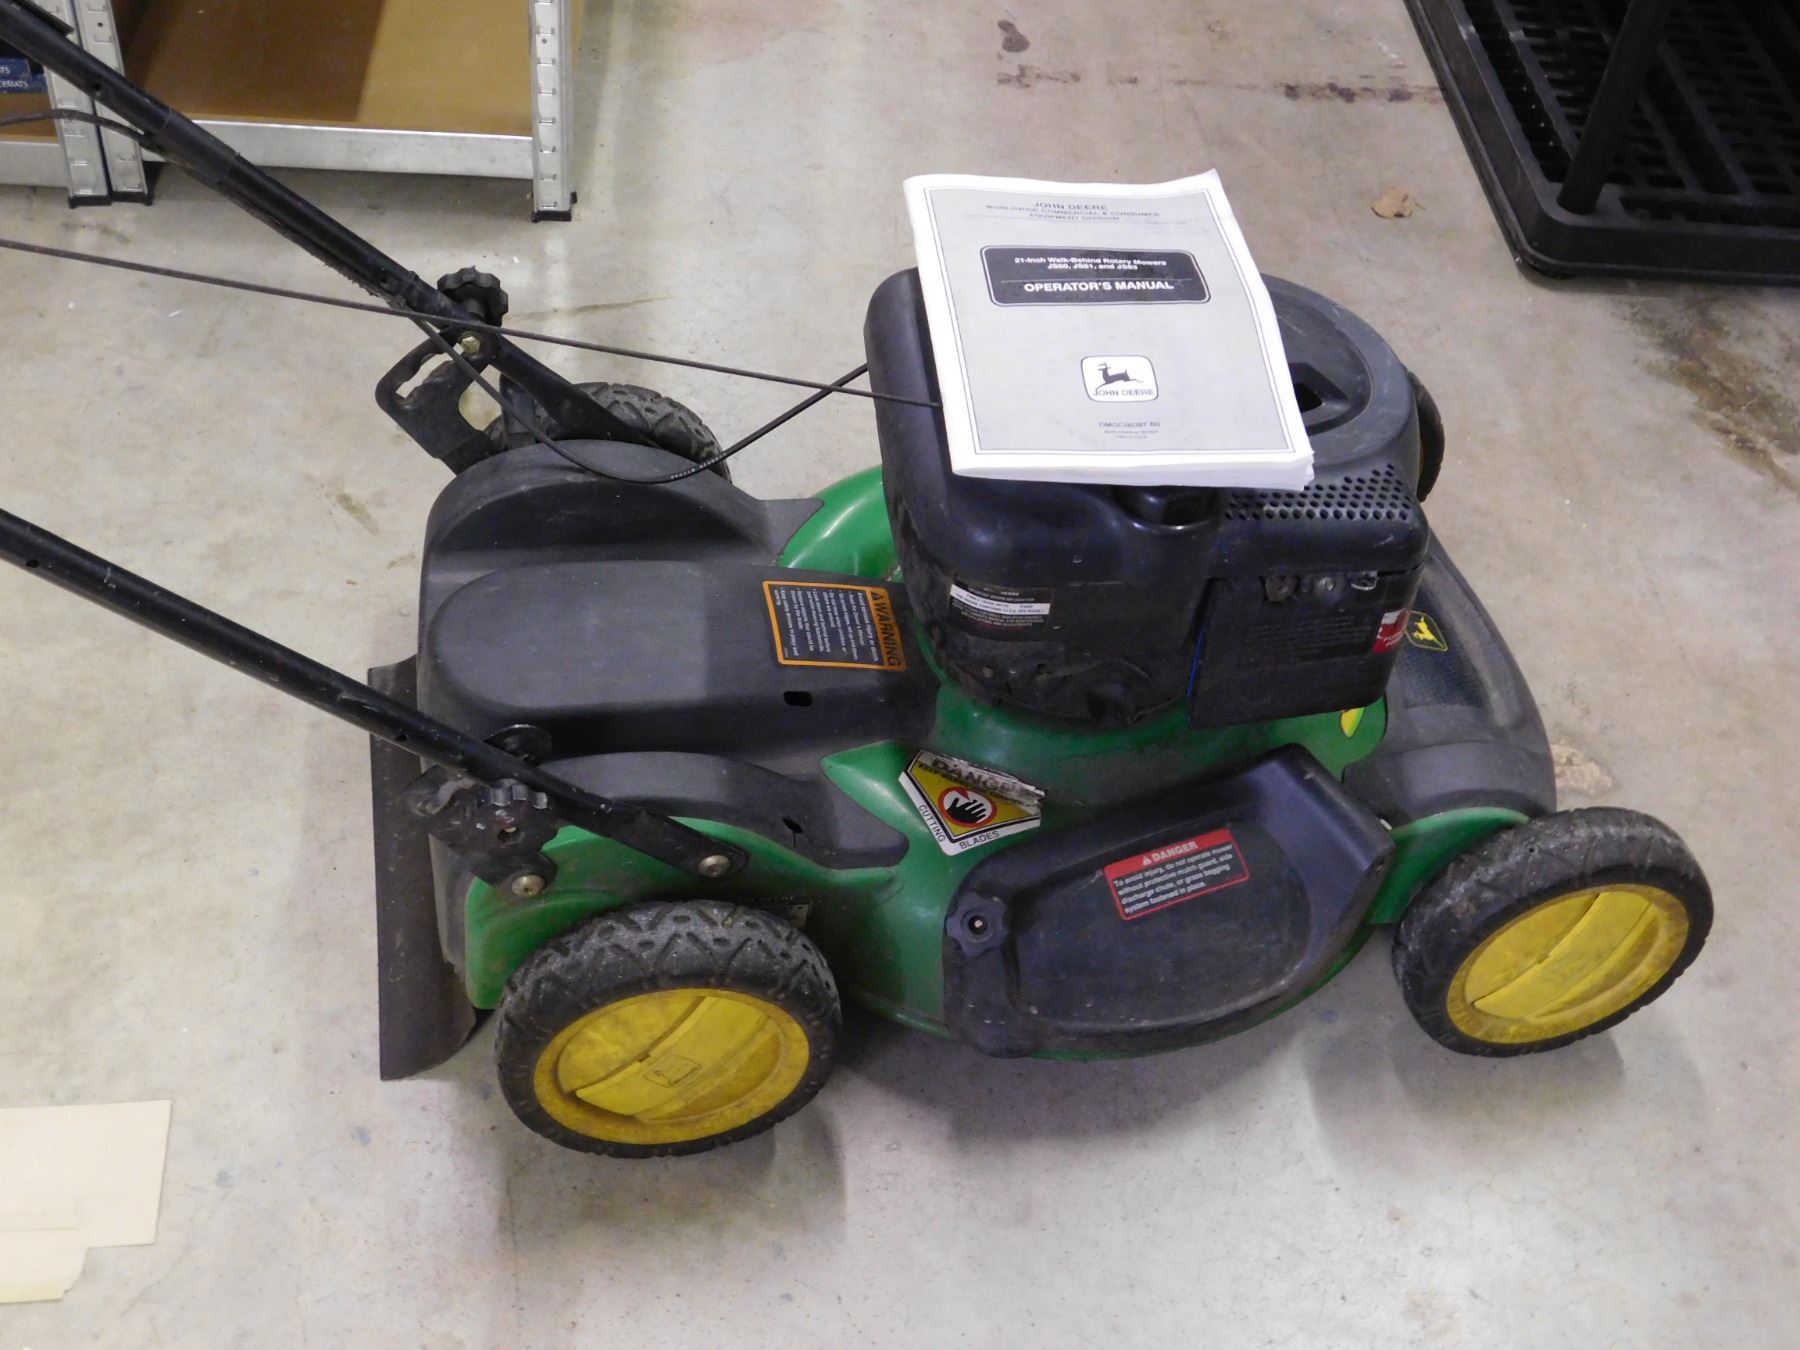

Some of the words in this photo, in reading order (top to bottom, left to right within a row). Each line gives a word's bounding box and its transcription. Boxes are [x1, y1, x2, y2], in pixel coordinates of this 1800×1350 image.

[1024, 281, 1112, 292] OPERATOR'S
[1115, 280, 1175, 290] MANUAL
[1122, 388, 1154, 396] DEERE
[872, 602, 901, 666] WARNING
[931, 758, 1022, 796] DANGE
[919, 804, 946, 842] CUTTING
[959, 831, 1000, 849] BLADES
[1151, 841, 1198, 862] DANGER
